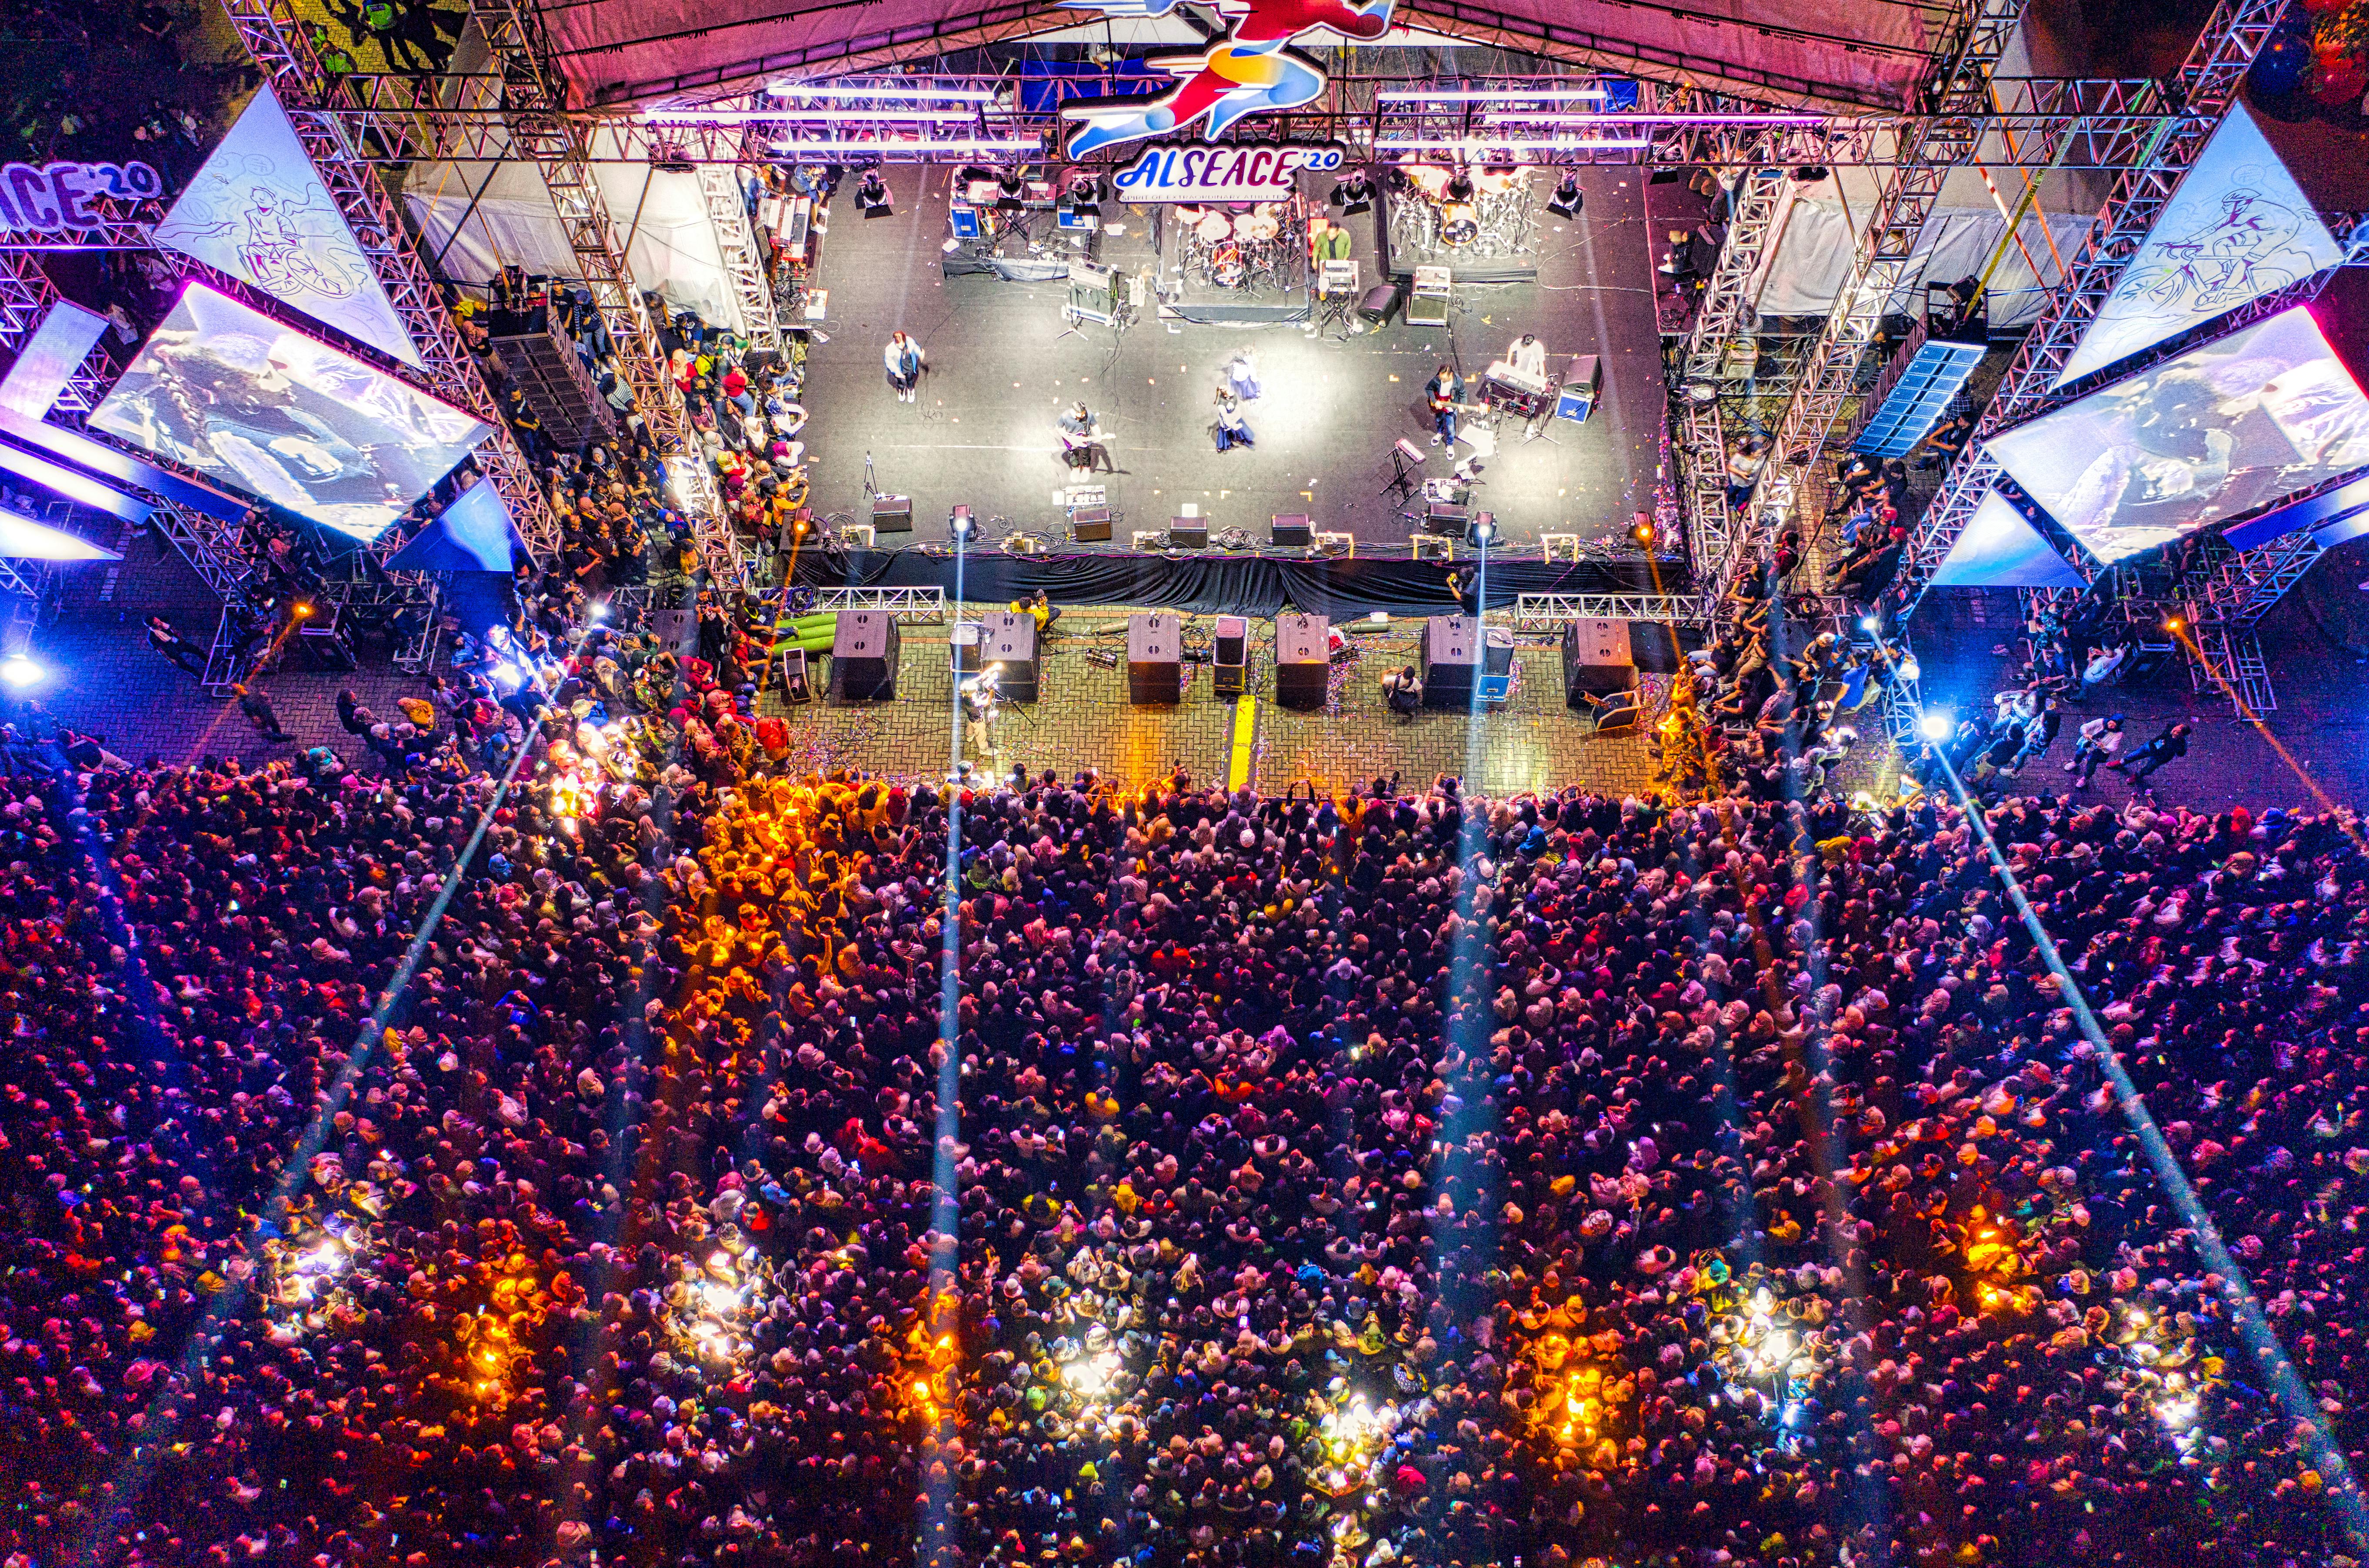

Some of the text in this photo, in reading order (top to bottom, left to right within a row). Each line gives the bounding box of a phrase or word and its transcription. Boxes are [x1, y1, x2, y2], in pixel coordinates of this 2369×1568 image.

[87, 165, 154, 194] '20
[1116, 150, 1341, 188] ALSEACE '20
